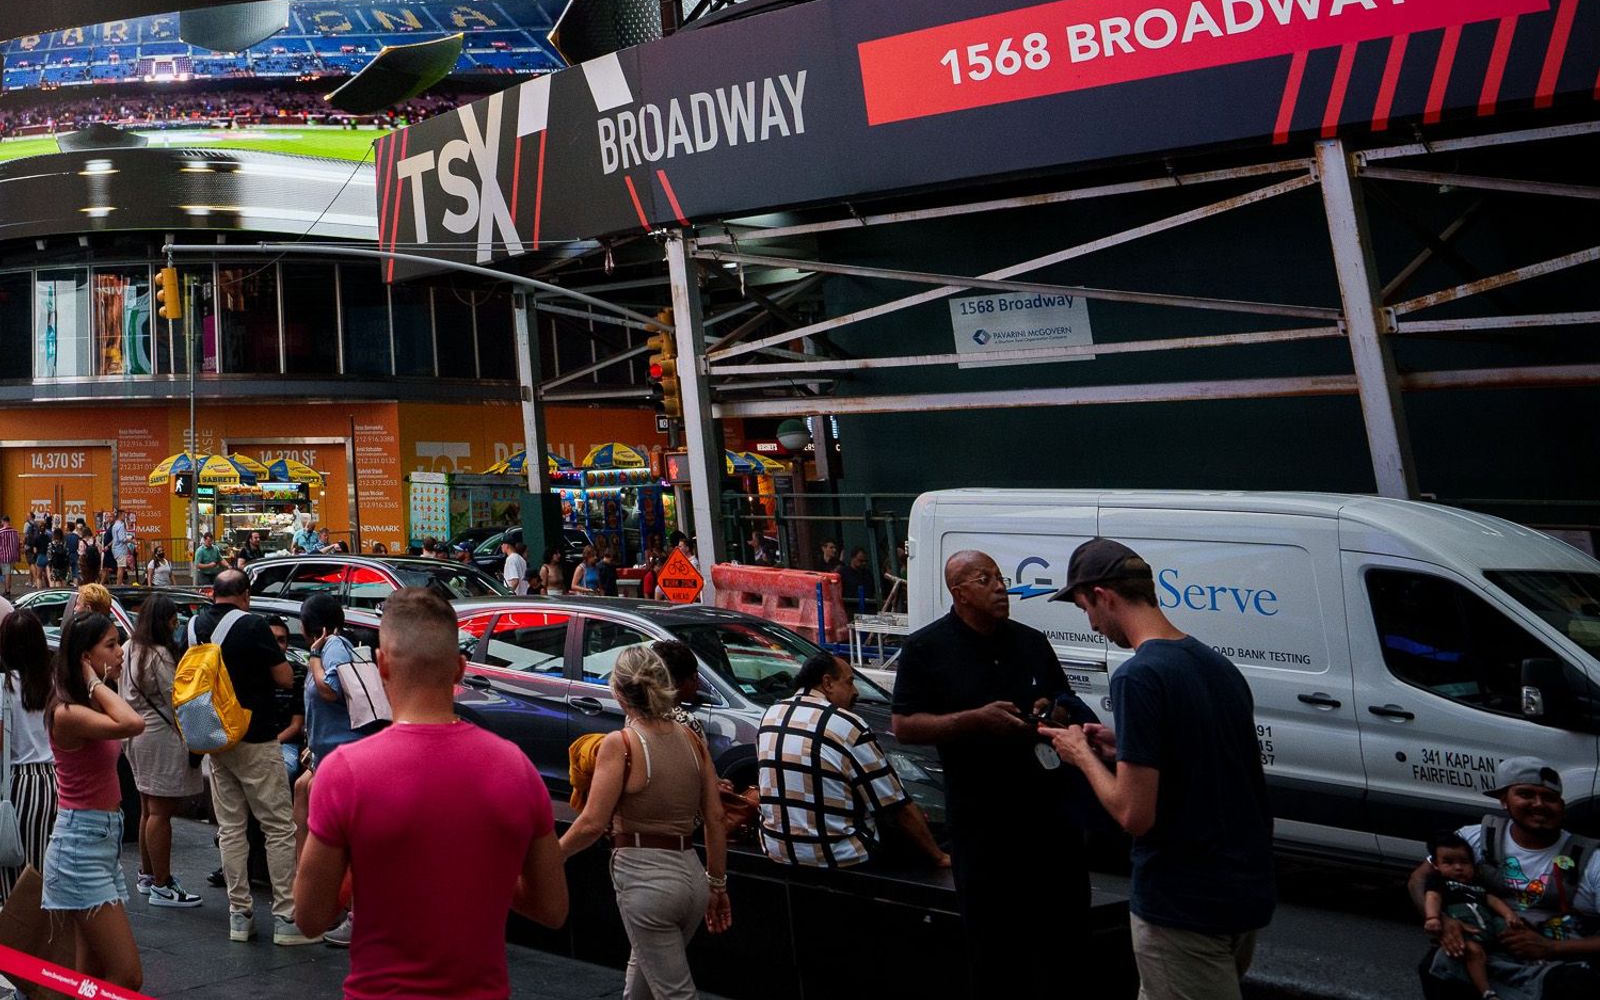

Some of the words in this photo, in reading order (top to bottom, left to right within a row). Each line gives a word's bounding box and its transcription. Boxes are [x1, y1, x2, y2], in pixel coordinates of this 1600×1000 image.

[939, 32, 1052, 86] 1568
[597, 70, 807, 176] BROADWAY
[396, 90, 526, 265] TSX
[960, 299, 995, 316] 1568
[998, 293, 1074, 311] Broadway
[993, 331, 1027, 340] PAVARINI
[1028, 326, 1072, 337] McGOVERN
[31, 452, 68, 470] 14,370
[71, 452, 86, 468] SF
[302, 450, 317, 466] SF
[360, 524, 400, 532] NEWMARK
[1043, 630, 1105, 644] MAINTENANCE
[1211, 645, 1235, 658] OAD
[1238, 648, 1266, 661] BANK
[1269, 651, 1311, 665] TESTING
[1421, 748, 1441, 766] 341
[1445, 751, 1495, 773] KAPLAN
[1412, 765, 1478, 791] FAIRFIELD,
